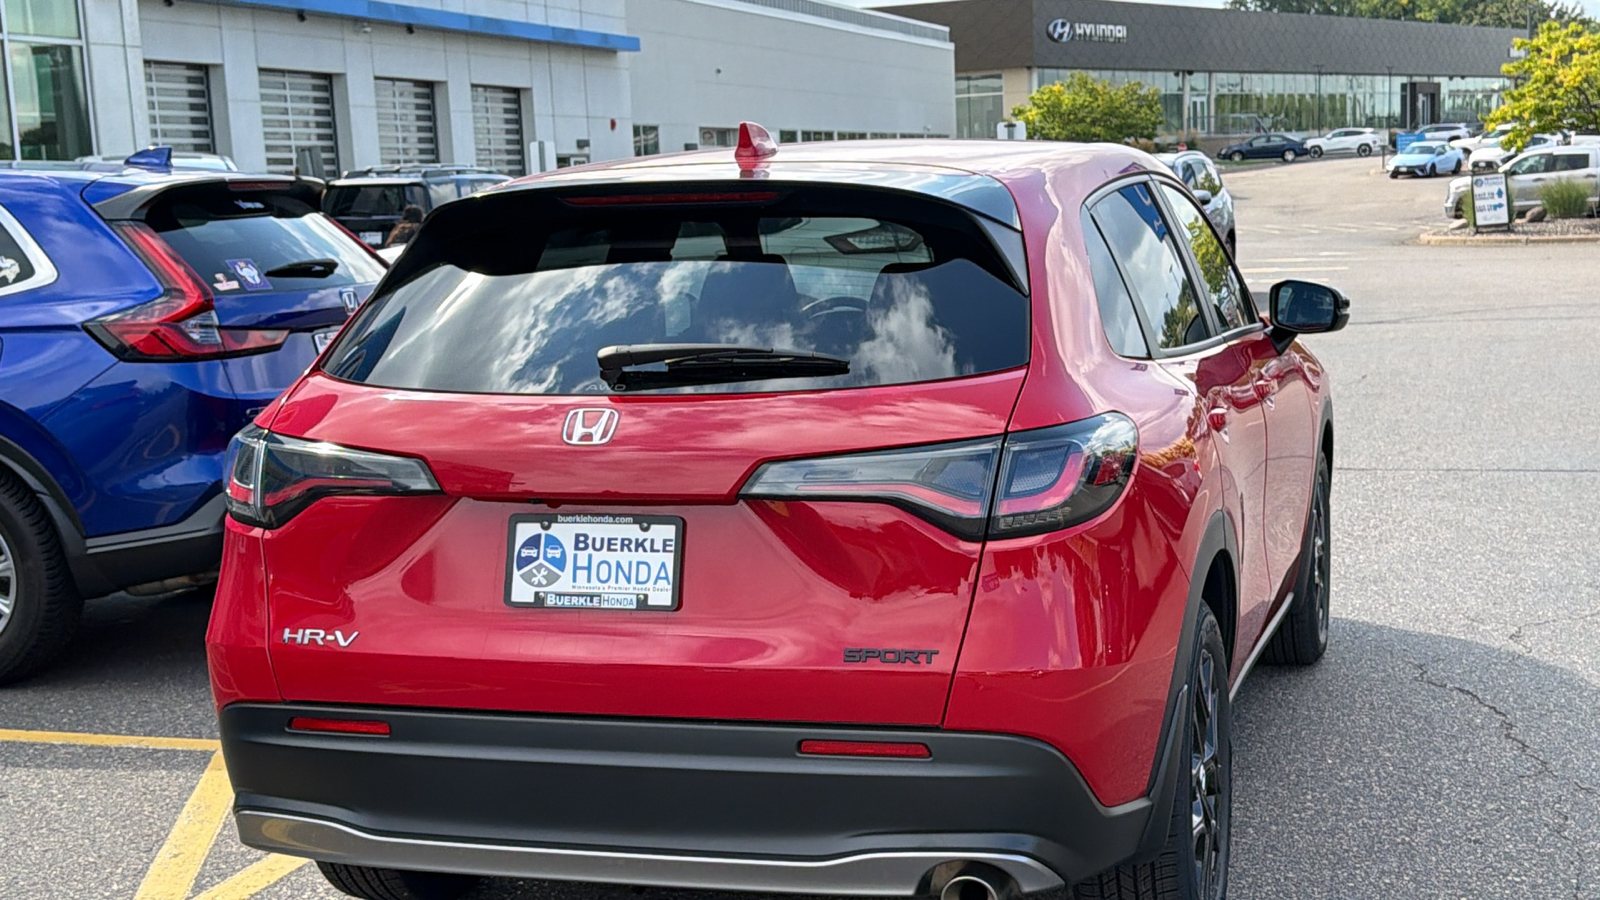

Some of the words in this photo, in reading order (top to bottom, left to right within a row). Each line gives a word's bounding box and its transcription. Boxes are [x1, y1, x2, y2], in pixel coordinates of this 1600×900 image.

[557, 515, 633, 523] buerklehonda.com
[574, 533, 674, 553] BUERKLE
[572, 553, 671, 586] HONDA
[547, 594, 600, 606] BUERKLE
[602, 596, 634, 606] HONDA
[283, 628, 359, 647] HR-V
[843, 648, 939, 664] SPORT
